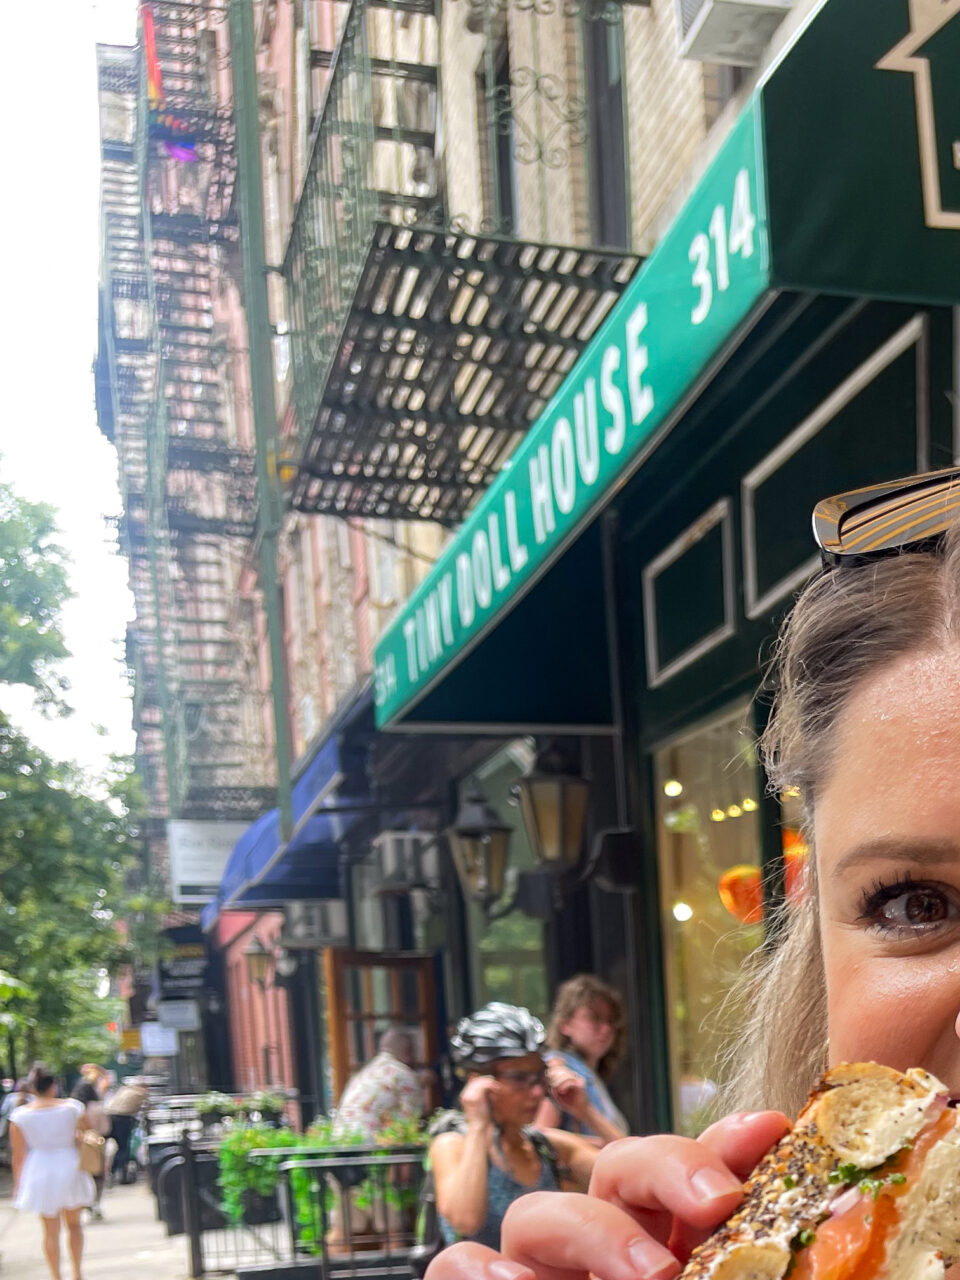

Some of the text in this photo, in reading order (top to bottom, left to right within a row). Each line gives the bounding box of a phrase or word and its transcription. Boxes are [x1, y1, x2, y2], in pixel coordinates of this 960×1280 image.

[403, 570, 454, 683] TINY
[455, 489, 529, 628] DOLL
[528, 301, 655, 545] HOUSE
[688, 167, 756, 325] 314
